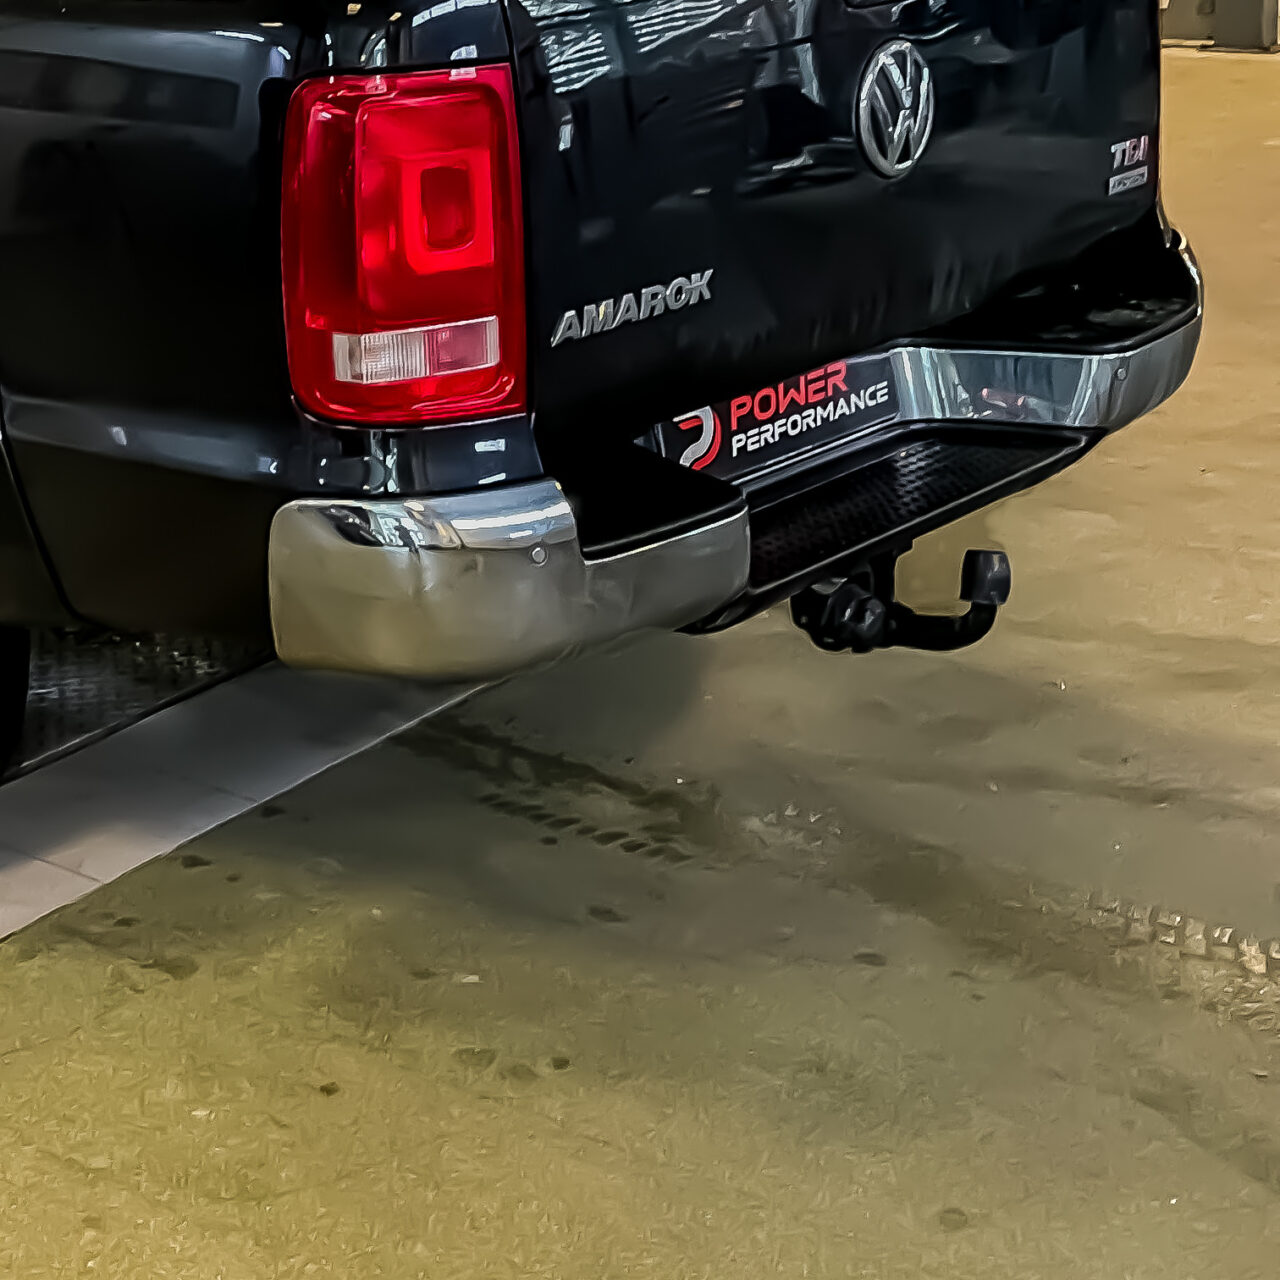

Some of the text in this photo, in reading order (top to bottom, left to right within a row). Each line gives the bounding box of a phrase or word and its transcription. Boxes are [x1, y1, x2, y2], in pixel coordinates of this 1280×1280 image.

[1110, 135, 1149, 170] TDI
[550, 269, 713, 348] AMAROK
[730, 361, 848, 431] POWER
[731, 380, 889, 458] PERFORMANCE
